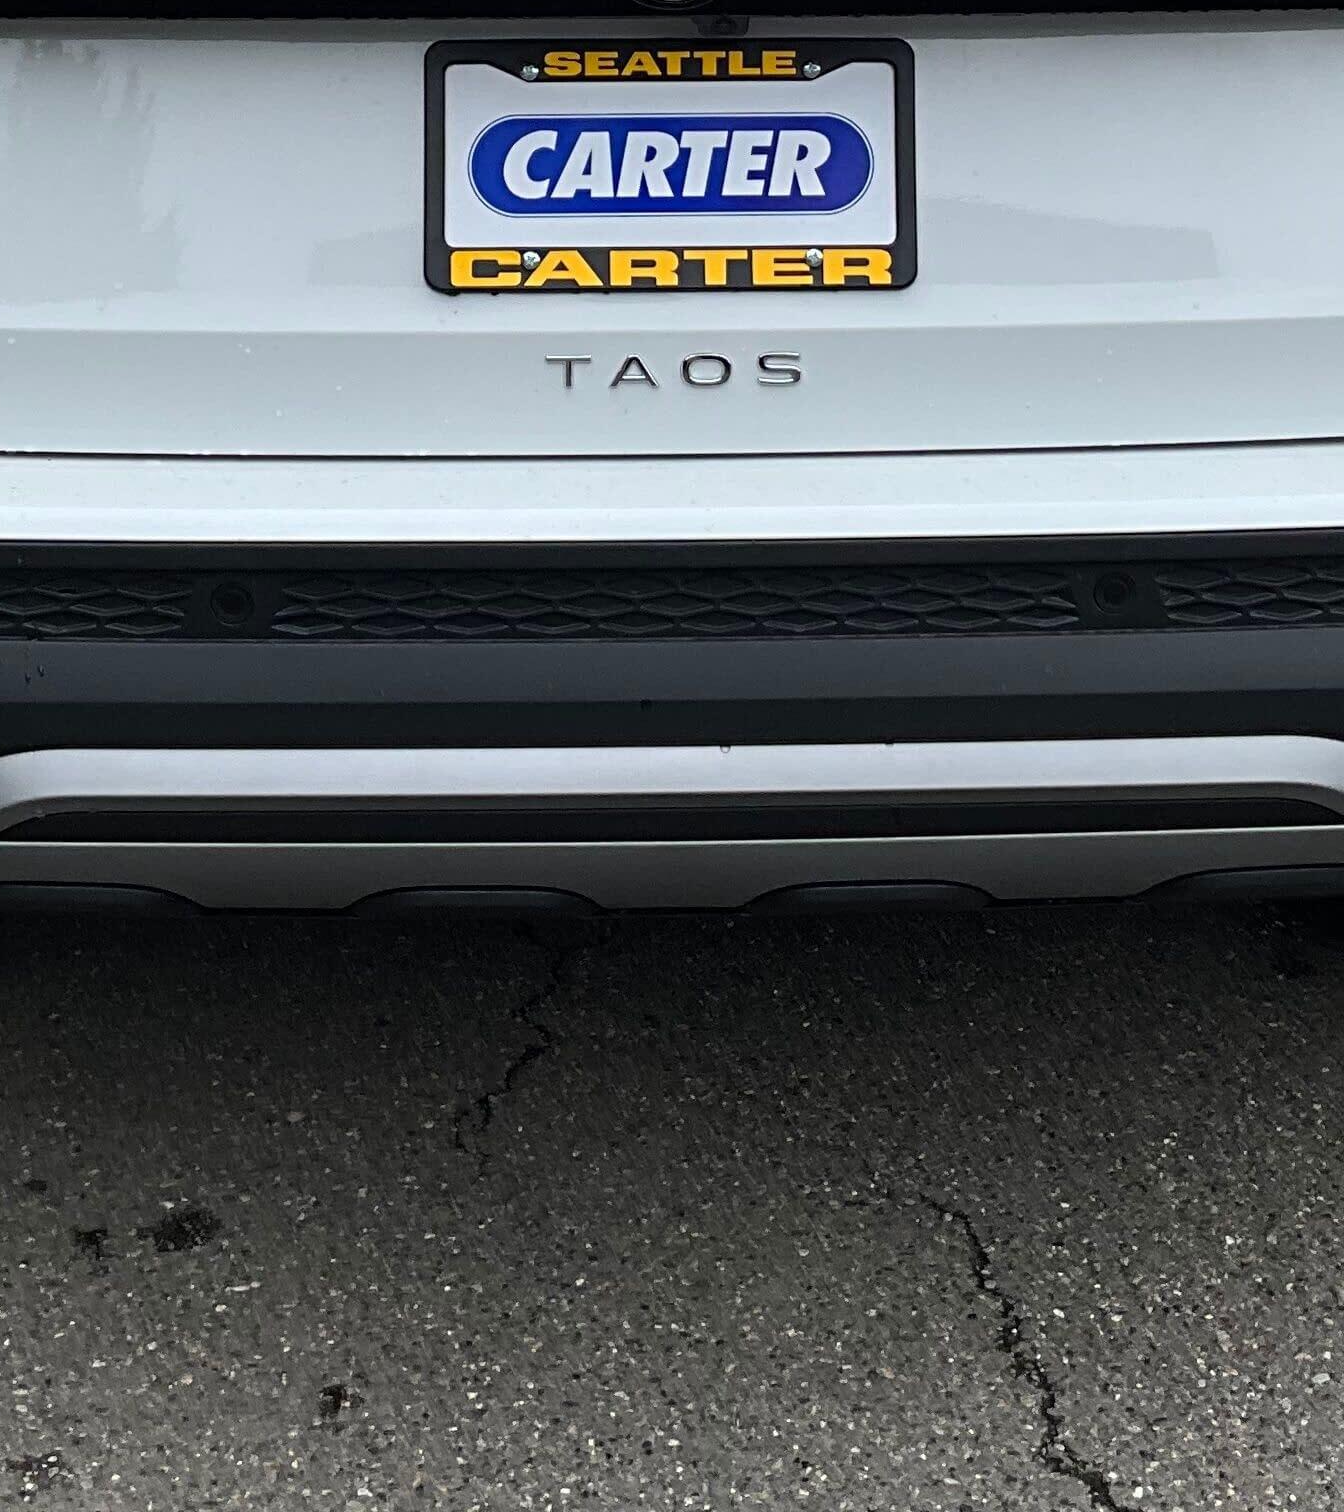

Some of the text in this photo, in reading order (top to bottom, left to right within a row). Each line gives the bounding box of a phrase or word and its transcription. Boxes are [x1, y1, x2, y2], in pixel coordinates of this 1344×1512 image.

[543, 50, 797, 77] SEATTLE
[503, 129, 831, 199] CARTER
[449, 249, 892, 287] CARTER
[544, 351, 802, 388] TAOS
